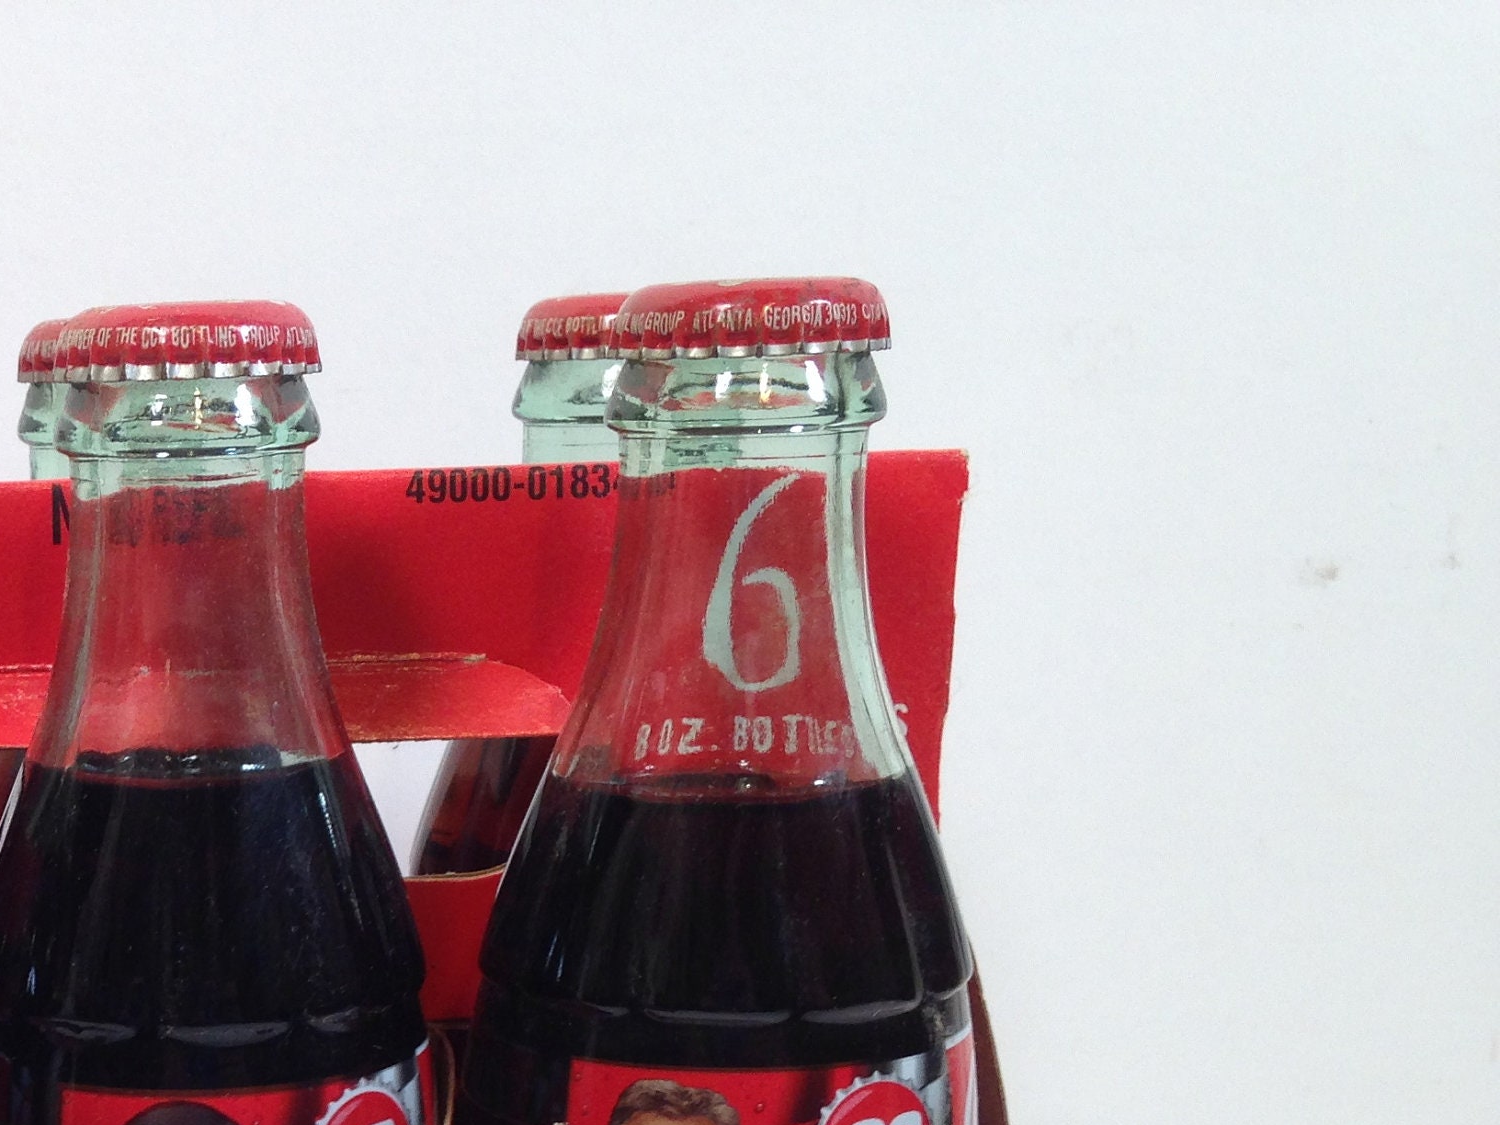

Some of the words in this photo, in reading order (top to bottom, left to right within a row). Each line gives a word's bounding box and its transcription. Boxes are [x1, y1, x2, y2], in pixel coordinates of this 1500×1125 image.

[764, 304, 822, 330] GEORGIA
[98, 327, 112, 348] OF
[116, 327, 138, 346] THE
[406, 464, 618, 503] 49000-0183
[703, 472, 800, 692] 6
